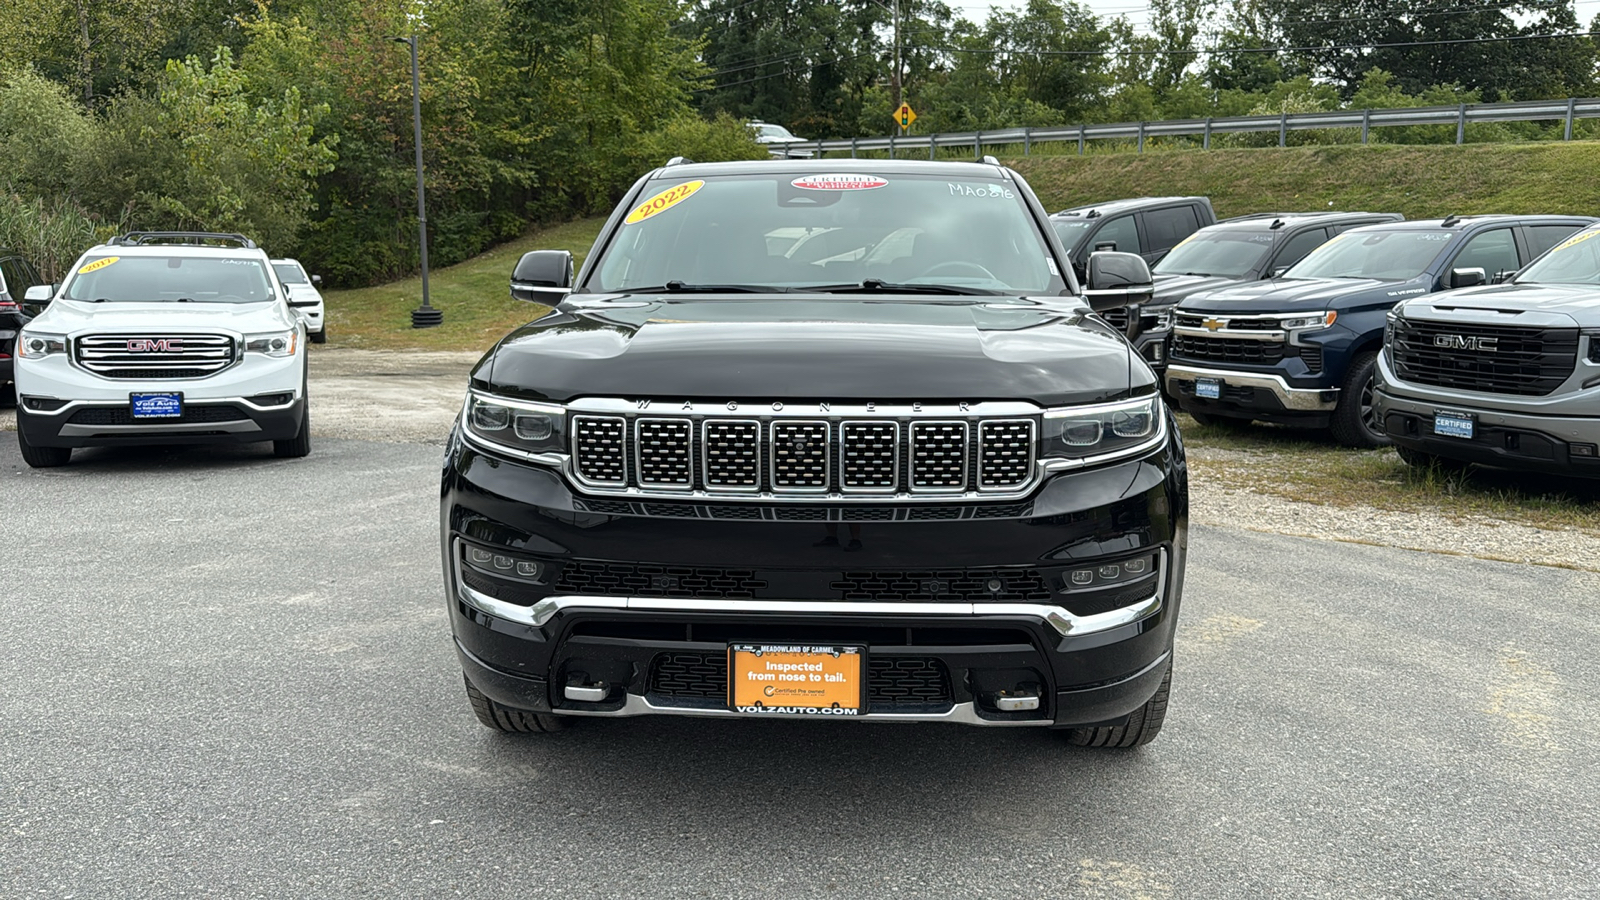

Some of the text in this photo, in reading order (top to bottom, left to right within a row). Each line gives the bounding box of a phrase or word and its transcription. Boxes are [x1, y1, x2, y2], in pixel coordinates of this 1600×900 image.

[640, 185, 692, 218] 2022
[85, 258, 111, 272] 2017
[127, 339, 184, 352] GMC
[1433, 333, 1499, 352] GMC
[636, 399, 970, 412] WAGONEER
[1435, 418, 1473, 429] CERTIFIED
[760, 645, 801, 653] MEADOWLAND
[811, 646, 835, 654] CARMEL
[766, 661, 823, 673] Inspected
[748, 671, 847, 683] from nose to tail.
[736, 706, 858, 715] VOLZAUTO.COM
